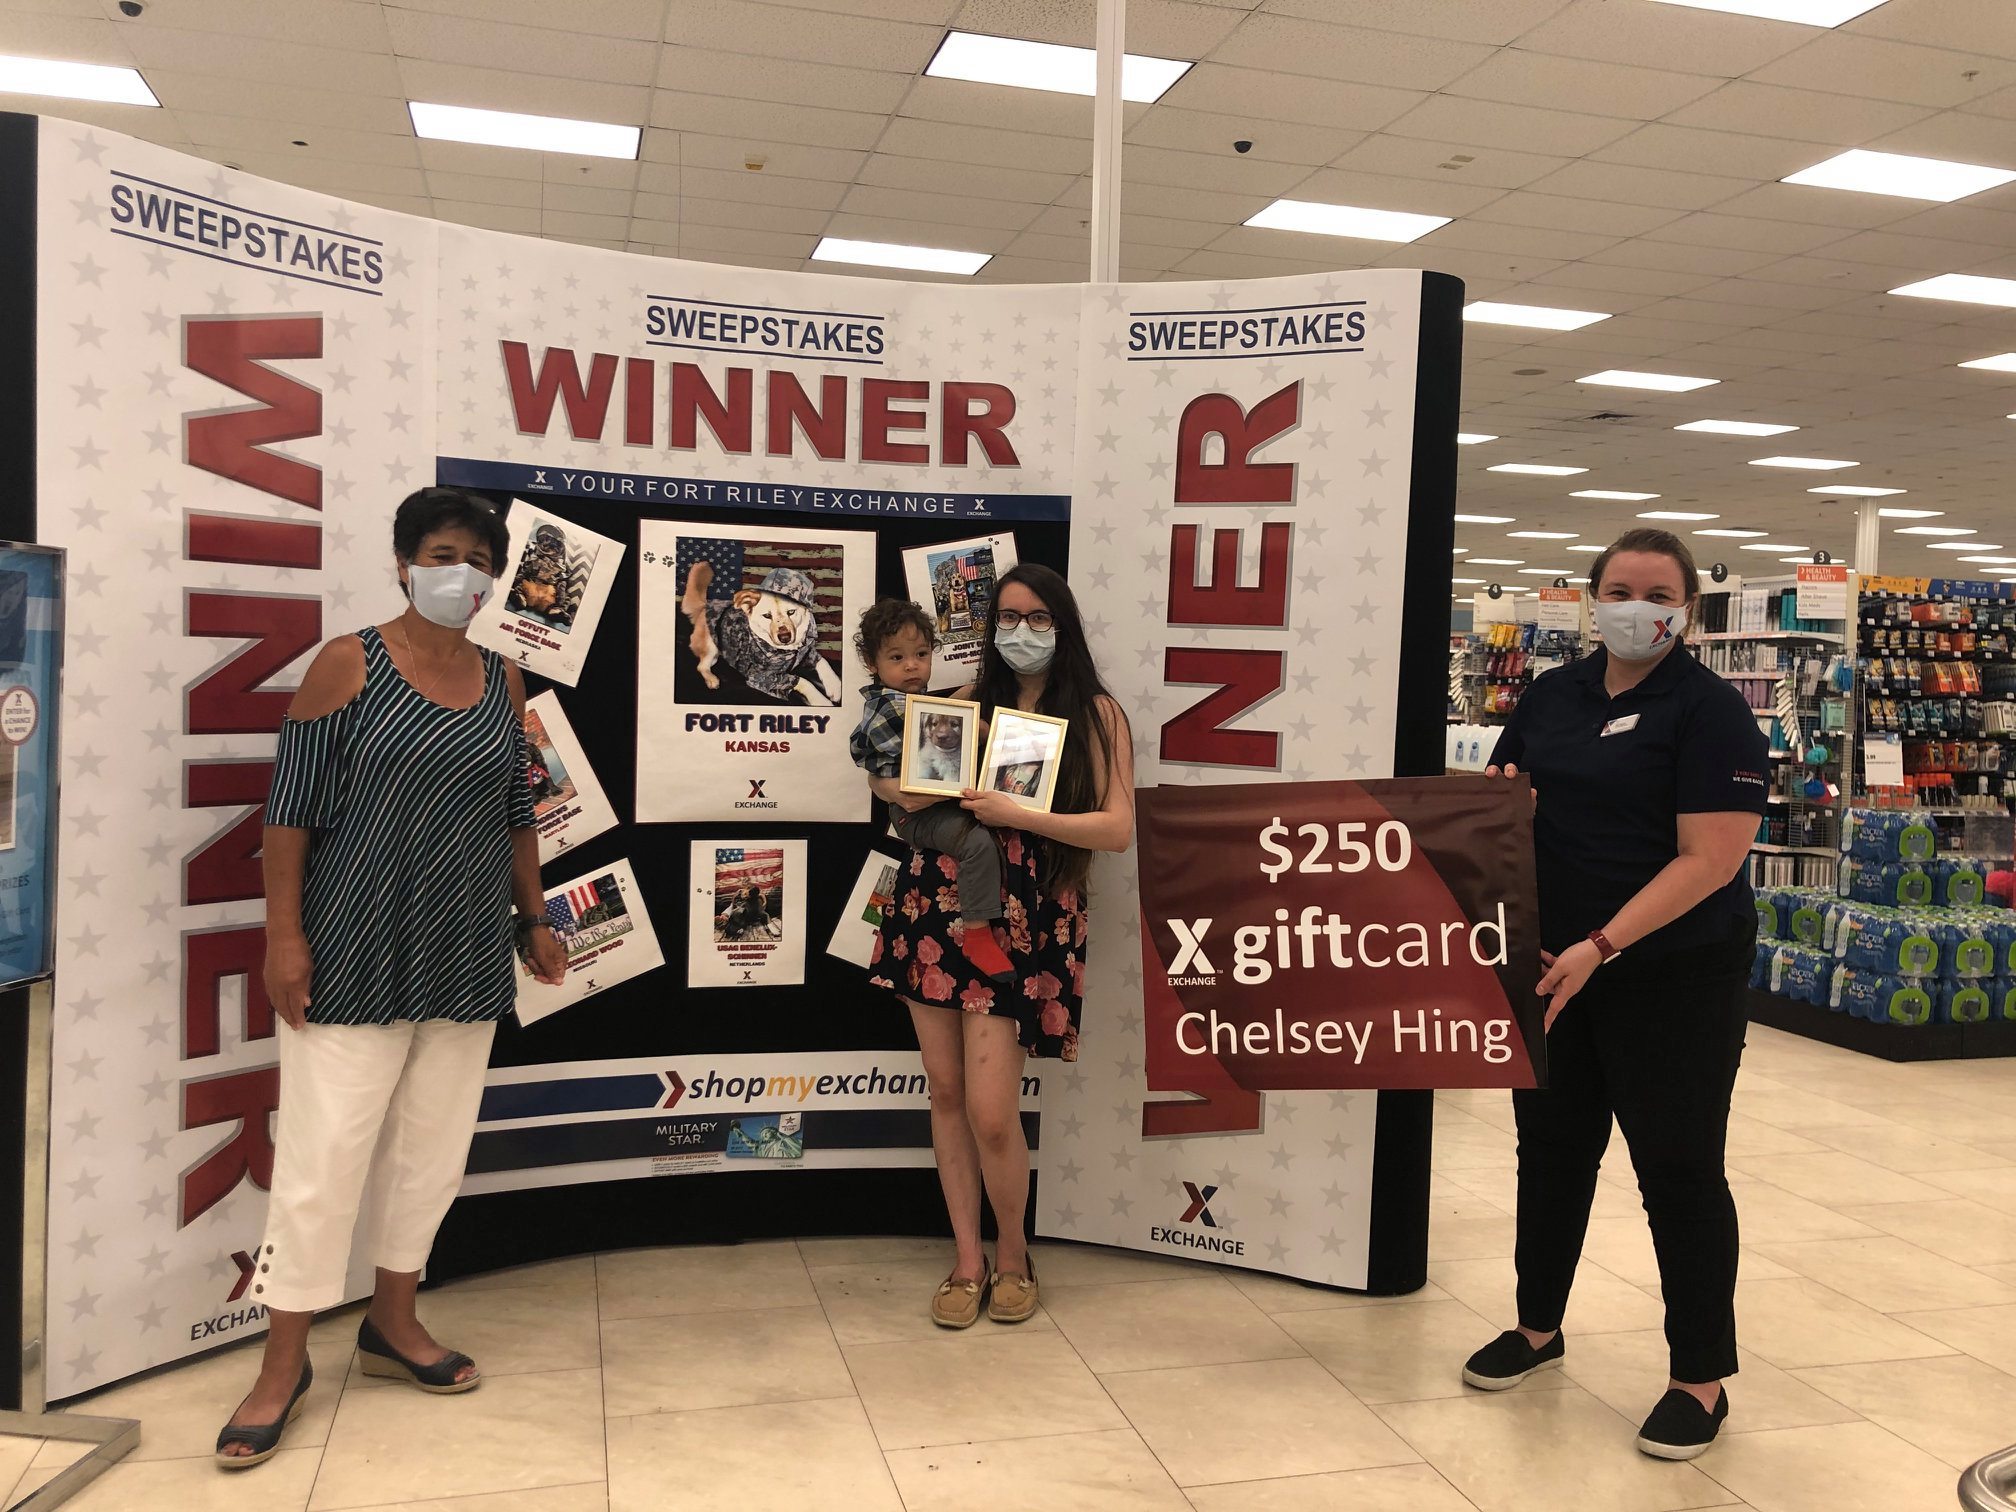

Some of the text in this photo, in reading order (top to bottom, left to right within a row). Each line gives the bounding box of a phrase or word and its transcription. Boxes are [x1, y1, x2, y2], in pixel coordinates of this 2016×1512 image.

[110, 184, 383, 285] SWEEPSTAKES
[646, 305, 884, 355] SWEEPSTAKES
[1127, 311, 1366, 351] SWEEPSTAKES
[499, 339, 1022, 469] WINNER
[527, 483, 553, 491] EXCHANGE
[562, 473, 955, 514] YOUR FORT RILEY EXCHANGE
[1819, 552, 1824, 562] 3
[1715, 565, 1722, 575] 3
[499, 622, 562, 651] AIR FORCE BASE
[518, 619, 551, 636] OFFUTT
[515, 637, 542, 650] NEBRASKA
[952, 641, 976, 652] JOINT
[685, 713, 831, 734] FORT RILEY
[725, 740, 791, 753] KANSAS
[177, 312, 323, 1231] WINNER
[537, 804, 568, 825] NDREWS
[734, 801, 778, 809] EXCHANGE
[537, 805, 583, 834] FORCE BASE
[543, 823, 570, 840] MARYLAND
[1258, 816, 1412, 883] $250
[599, 939, 624, 953] WOOD
[1232, 902, 1508, 985] giftcard
[573, 959, 598, 973] MISSOURI
[1167, 976, 1216, 987] EXCHANGE
[1175, 1008, 1513, 1065] Chelsey Hing
[655, 1121, 718, 1136] MILITARY
[1150, 1226, 1245, 1256] EXCHANGE
[191, 1303, 271, 1341] EXCHAN
